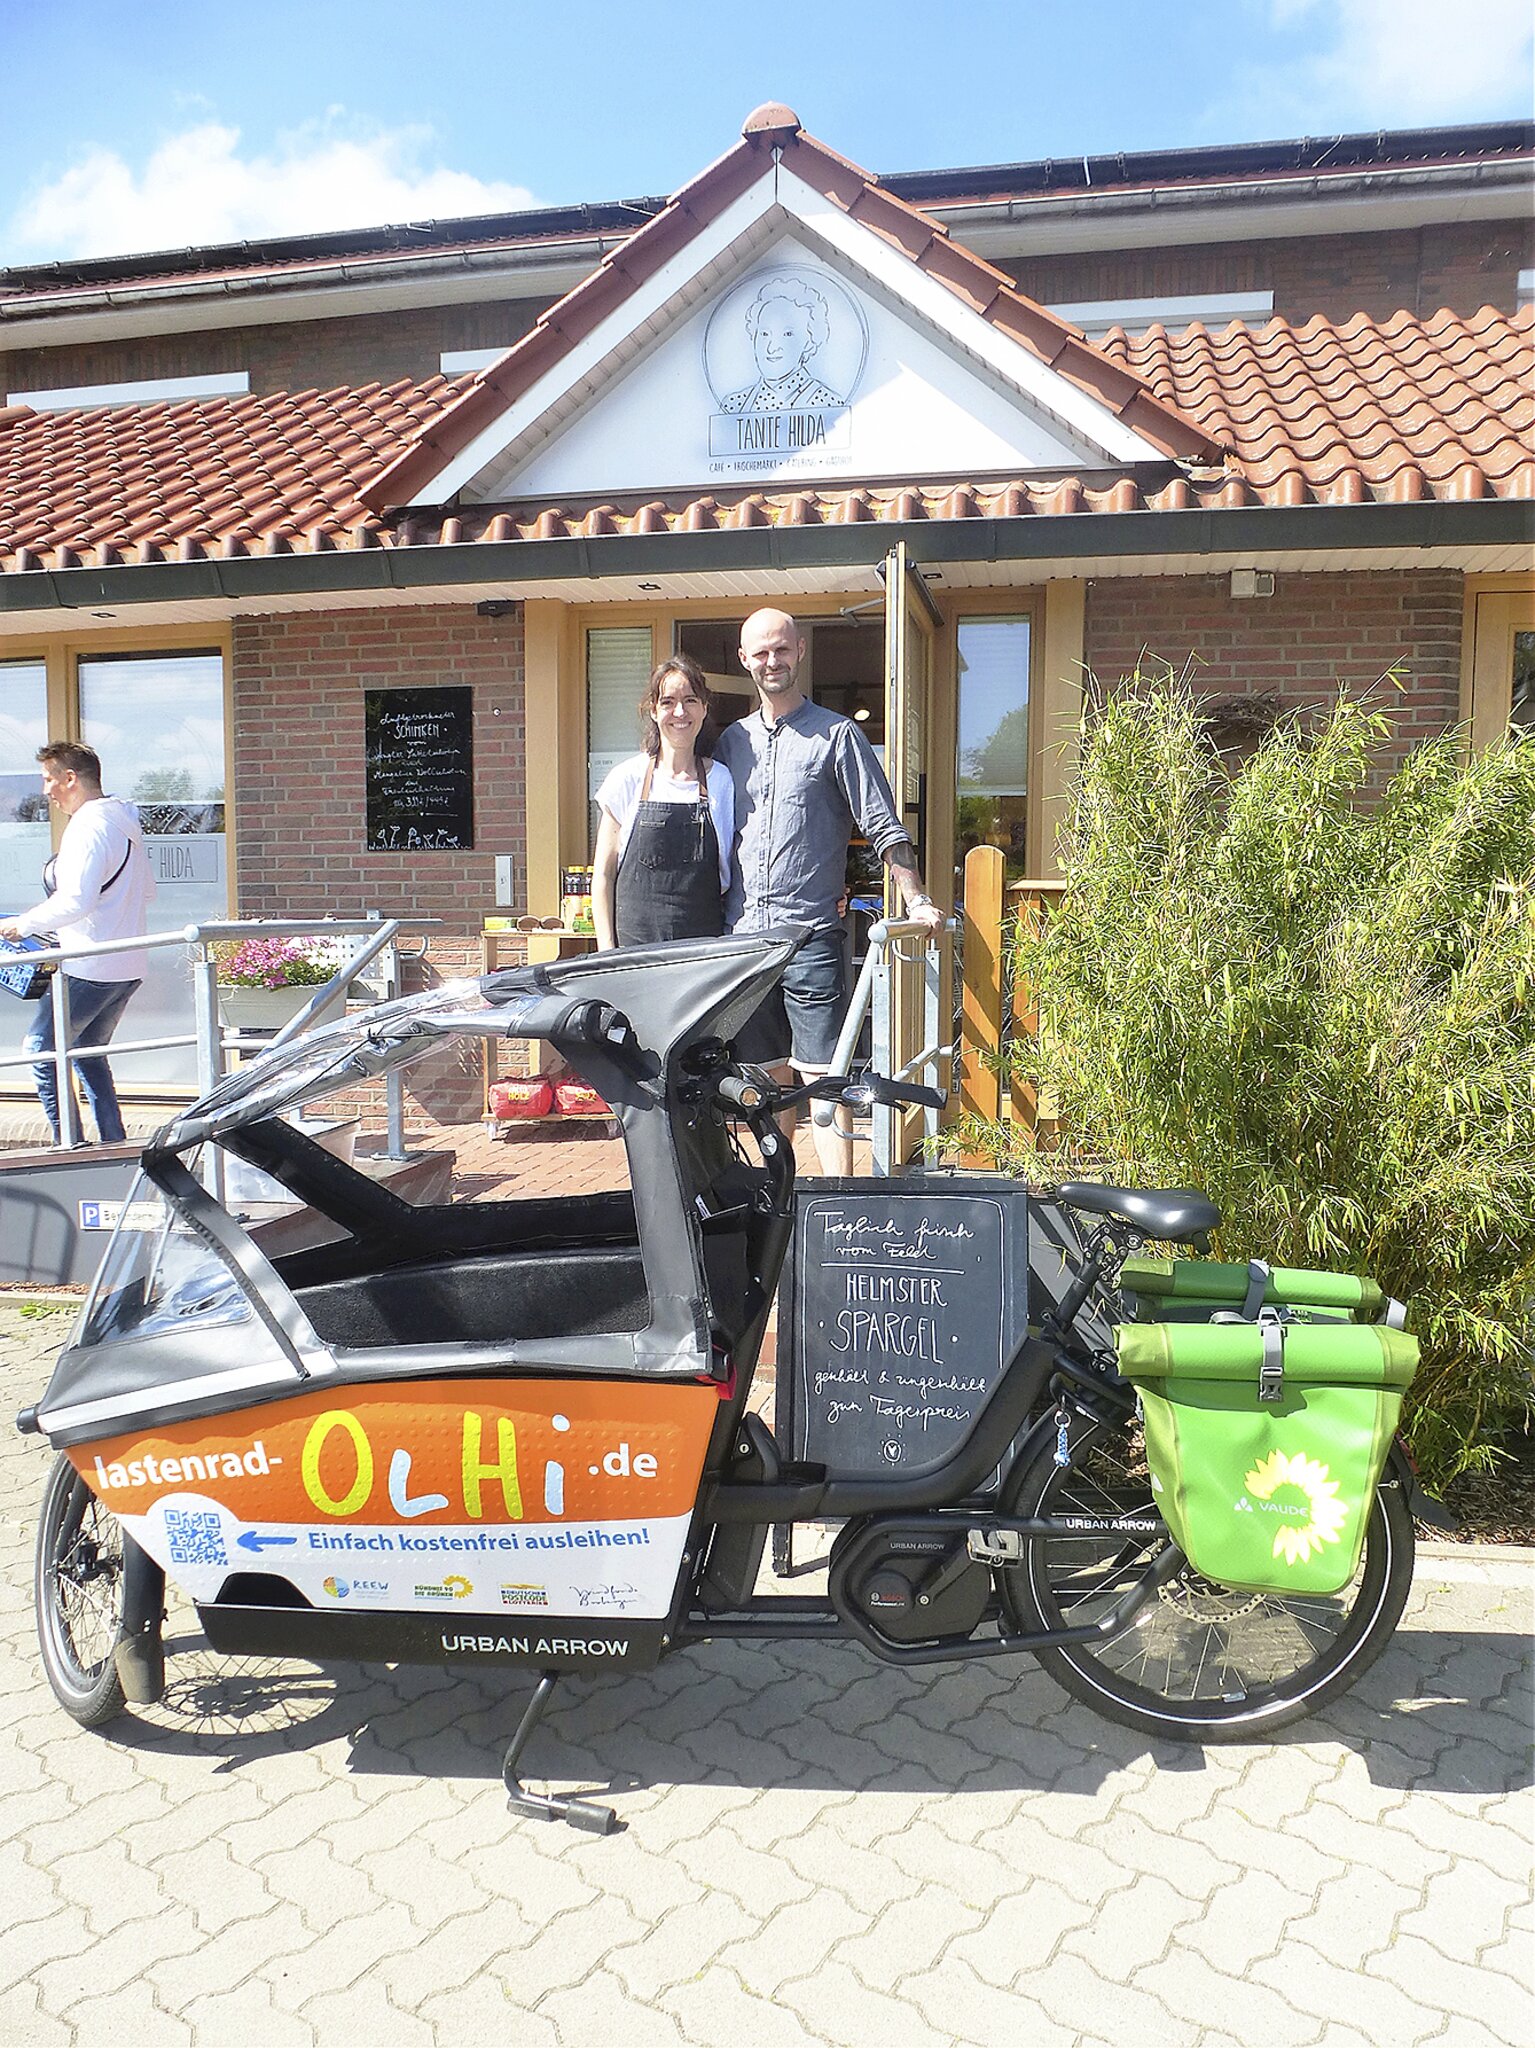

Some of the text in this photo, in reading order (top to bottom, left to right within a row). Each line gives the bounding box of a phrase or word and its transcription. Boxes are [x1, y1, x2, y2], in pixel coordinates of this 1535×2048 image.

[736, 414, 826, 450] TANTE HILDA
[393, 723, 440, 740] SCHINKEN
[160, 847, 195, 879] HILDA
[914, 1217, 975, 1248] frisch
[836, 1241, 937, 1260] vom Feld
[846, 1273, 948, 1307] HELMSTER
[830, 1310, 944, 1364] SPARGEL
[879, 1371, 890, 1384] &
[827, 1393, 971, 1431] zum Tagespreis
[94, 1440, 283, 1489] lastenrad-
[1259, 1502, 1309, 1517] VAUDE
[1066, 1518, 1156, 1531] URBAN ARROW
[308, 1528, 651, 1551] Einfach kostenfrei ausleihen!
[890, 1542, 945, 1550] URBAN ARROW
[441, 1635, 629, 1656] URBAN ARROW
